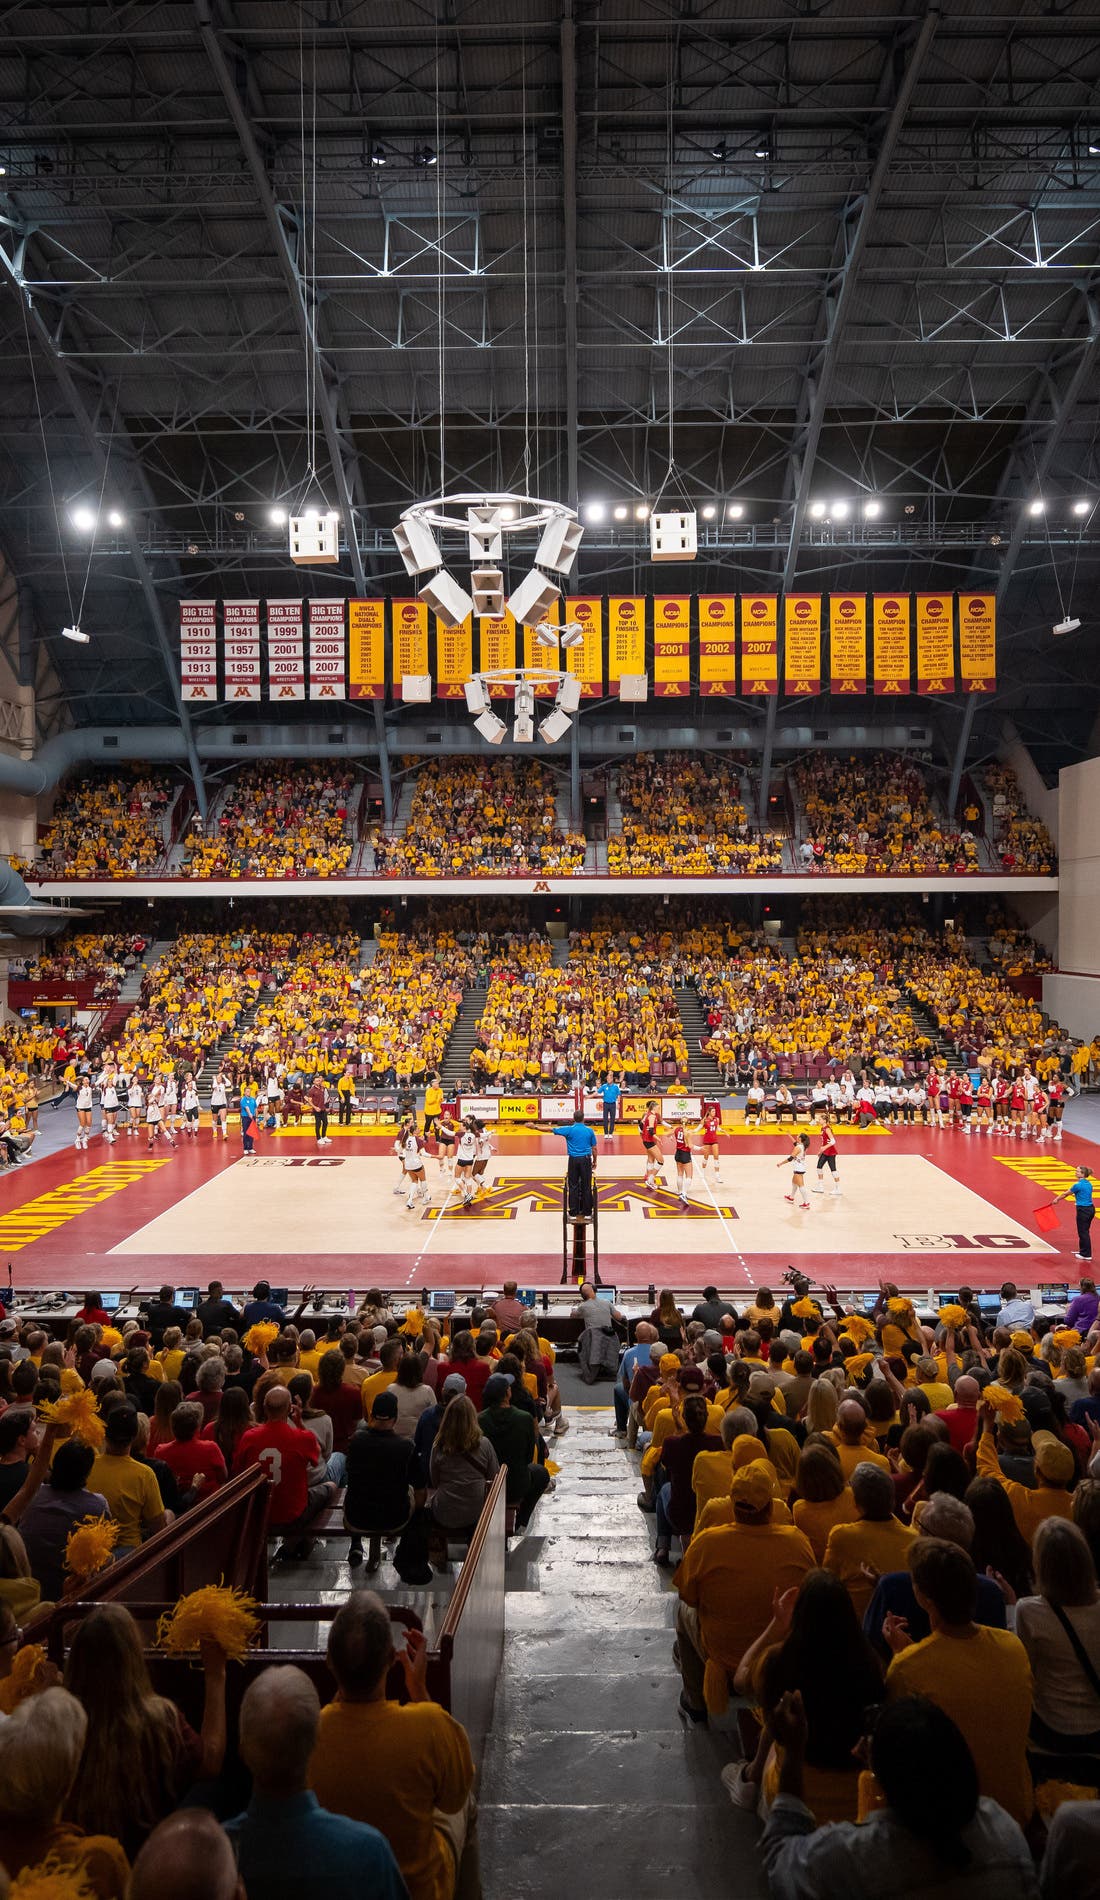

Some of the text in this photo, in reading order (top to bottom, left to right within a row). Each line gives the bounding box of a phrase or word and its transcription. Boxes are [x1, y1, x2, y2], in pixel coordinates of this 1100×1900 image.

[183, 608, 213, 616] BIG TEN
[226, 608, 256, 616] BIG TEN
[270, 607, 300, 615] BIG TEN
[312, 607, 342, 615] BIG TEN
[187, 628, 210, 636] 1910
[231, 628, 253, 636] 1941
[274, 627, 297, 636] 1999
[316, 627, 338, 635] 2003
[187, 646, 210, 654] 1912
[231, 646, 253, 654] 1957
[275, 645, 296, 654] 2001
[316, 645, 338, 653] 2006
[660, 645, 684, 654] 2001
[705, 644, 729, 653] 2002
[747, 643, 771, 653] 2007
[188, 664, 210, 672] 1913
[231, 664, 254, 672] 1959
[275, 663, 298, 672] 2002
[316, 663, 339, 671] 2007
[664, 683, 681, 694] M
[708, 683, 726, 693] M
[751, 681, 769, 692] M
[794, 681, 812, 692] M
[840, 680, 858, 691] M
[883, 681, 901, 692] M
[927, 680, 946, 691] M
[969, 680, 987, 691] M
[190, 687, 208, 697] M
[234, 687, 251, 697] M
[279, 687, 296, 697] M
[319, 686, 336, 696] M
[358, 686, 376, 696] M
[533, 881, 551, 892] M
[259, 1448, 281, 1486] 3
